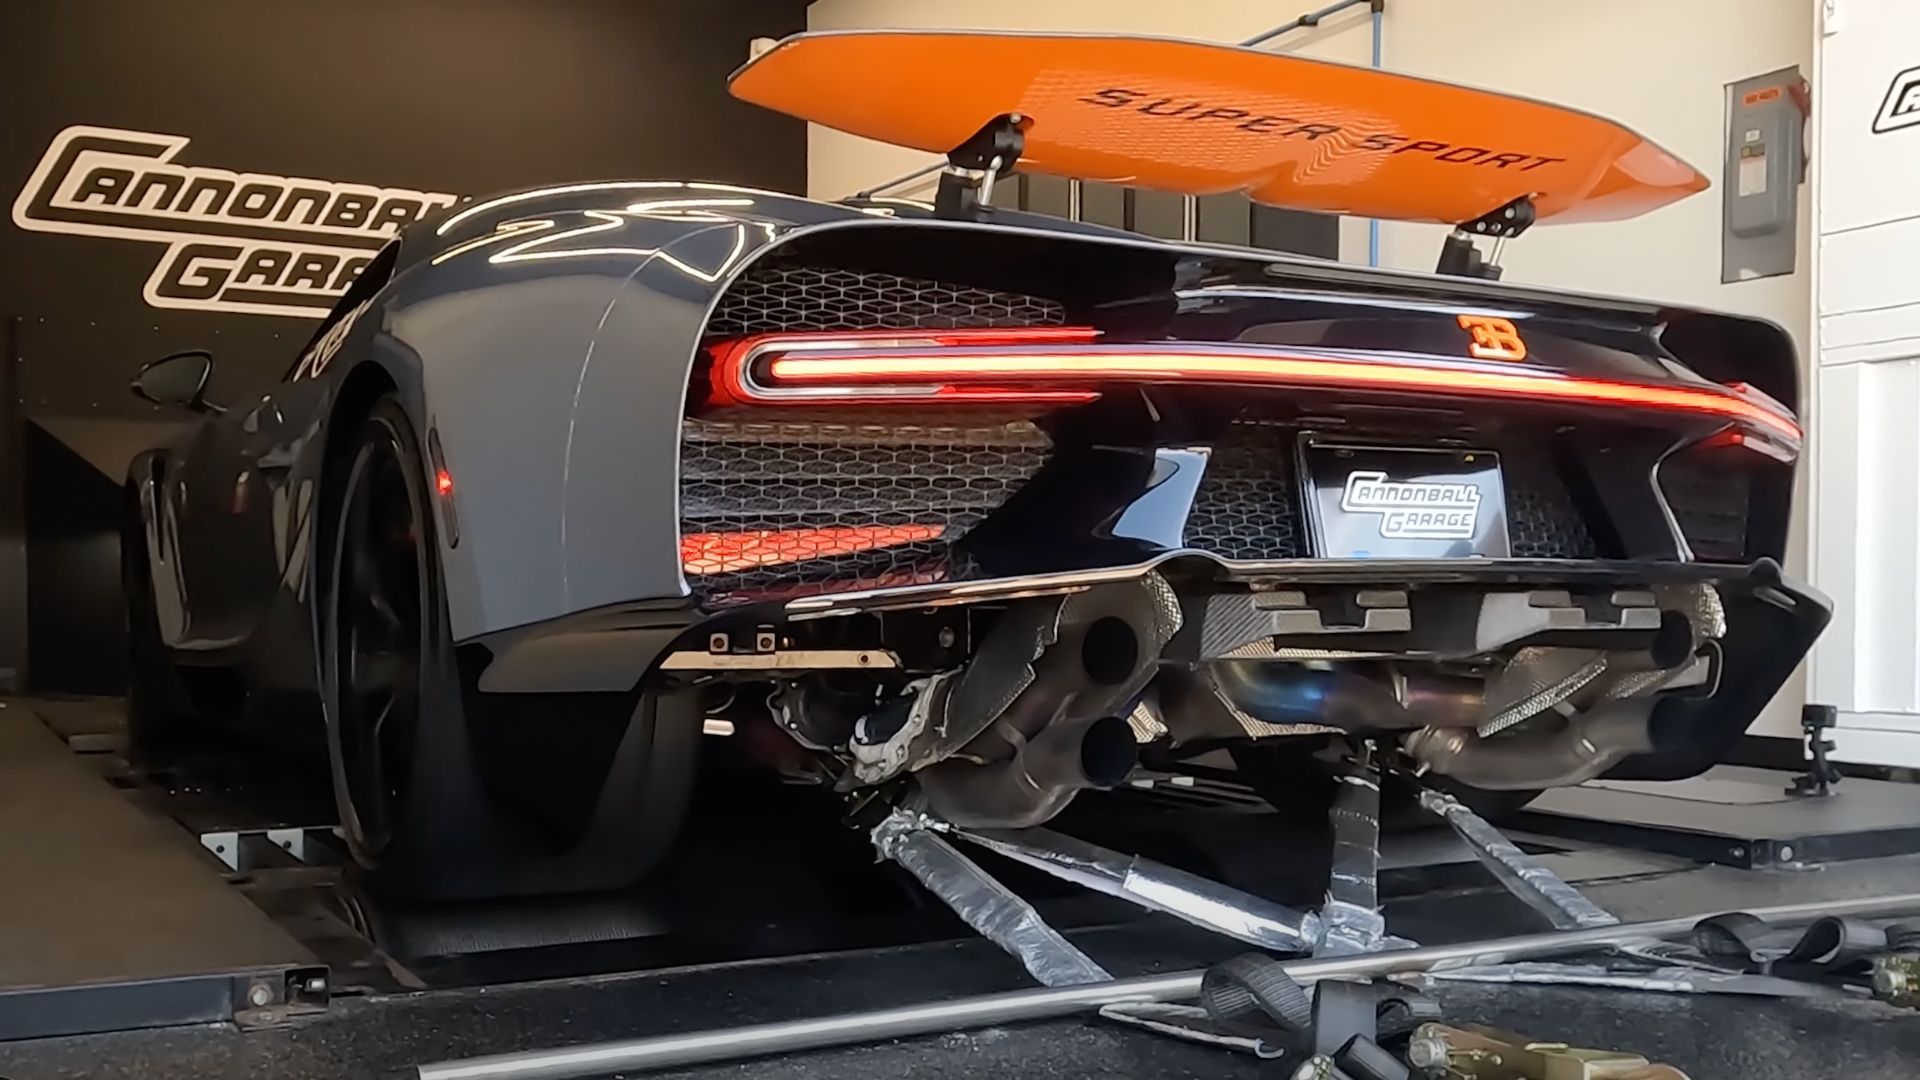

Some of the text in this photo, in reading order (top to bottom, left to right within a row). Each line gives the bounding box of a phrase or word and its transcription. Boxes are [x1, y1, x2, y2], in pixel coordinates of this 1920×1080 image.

[1078, 88, 1567, 171] SUPER SPORT
[13, 126, 457, 252] CANNONBA
[145, 241, 373, 314] GARA
[1342, 471, 1481, 512] CANNONBALL
[1381, 511, 1476, 538] GARAGE
